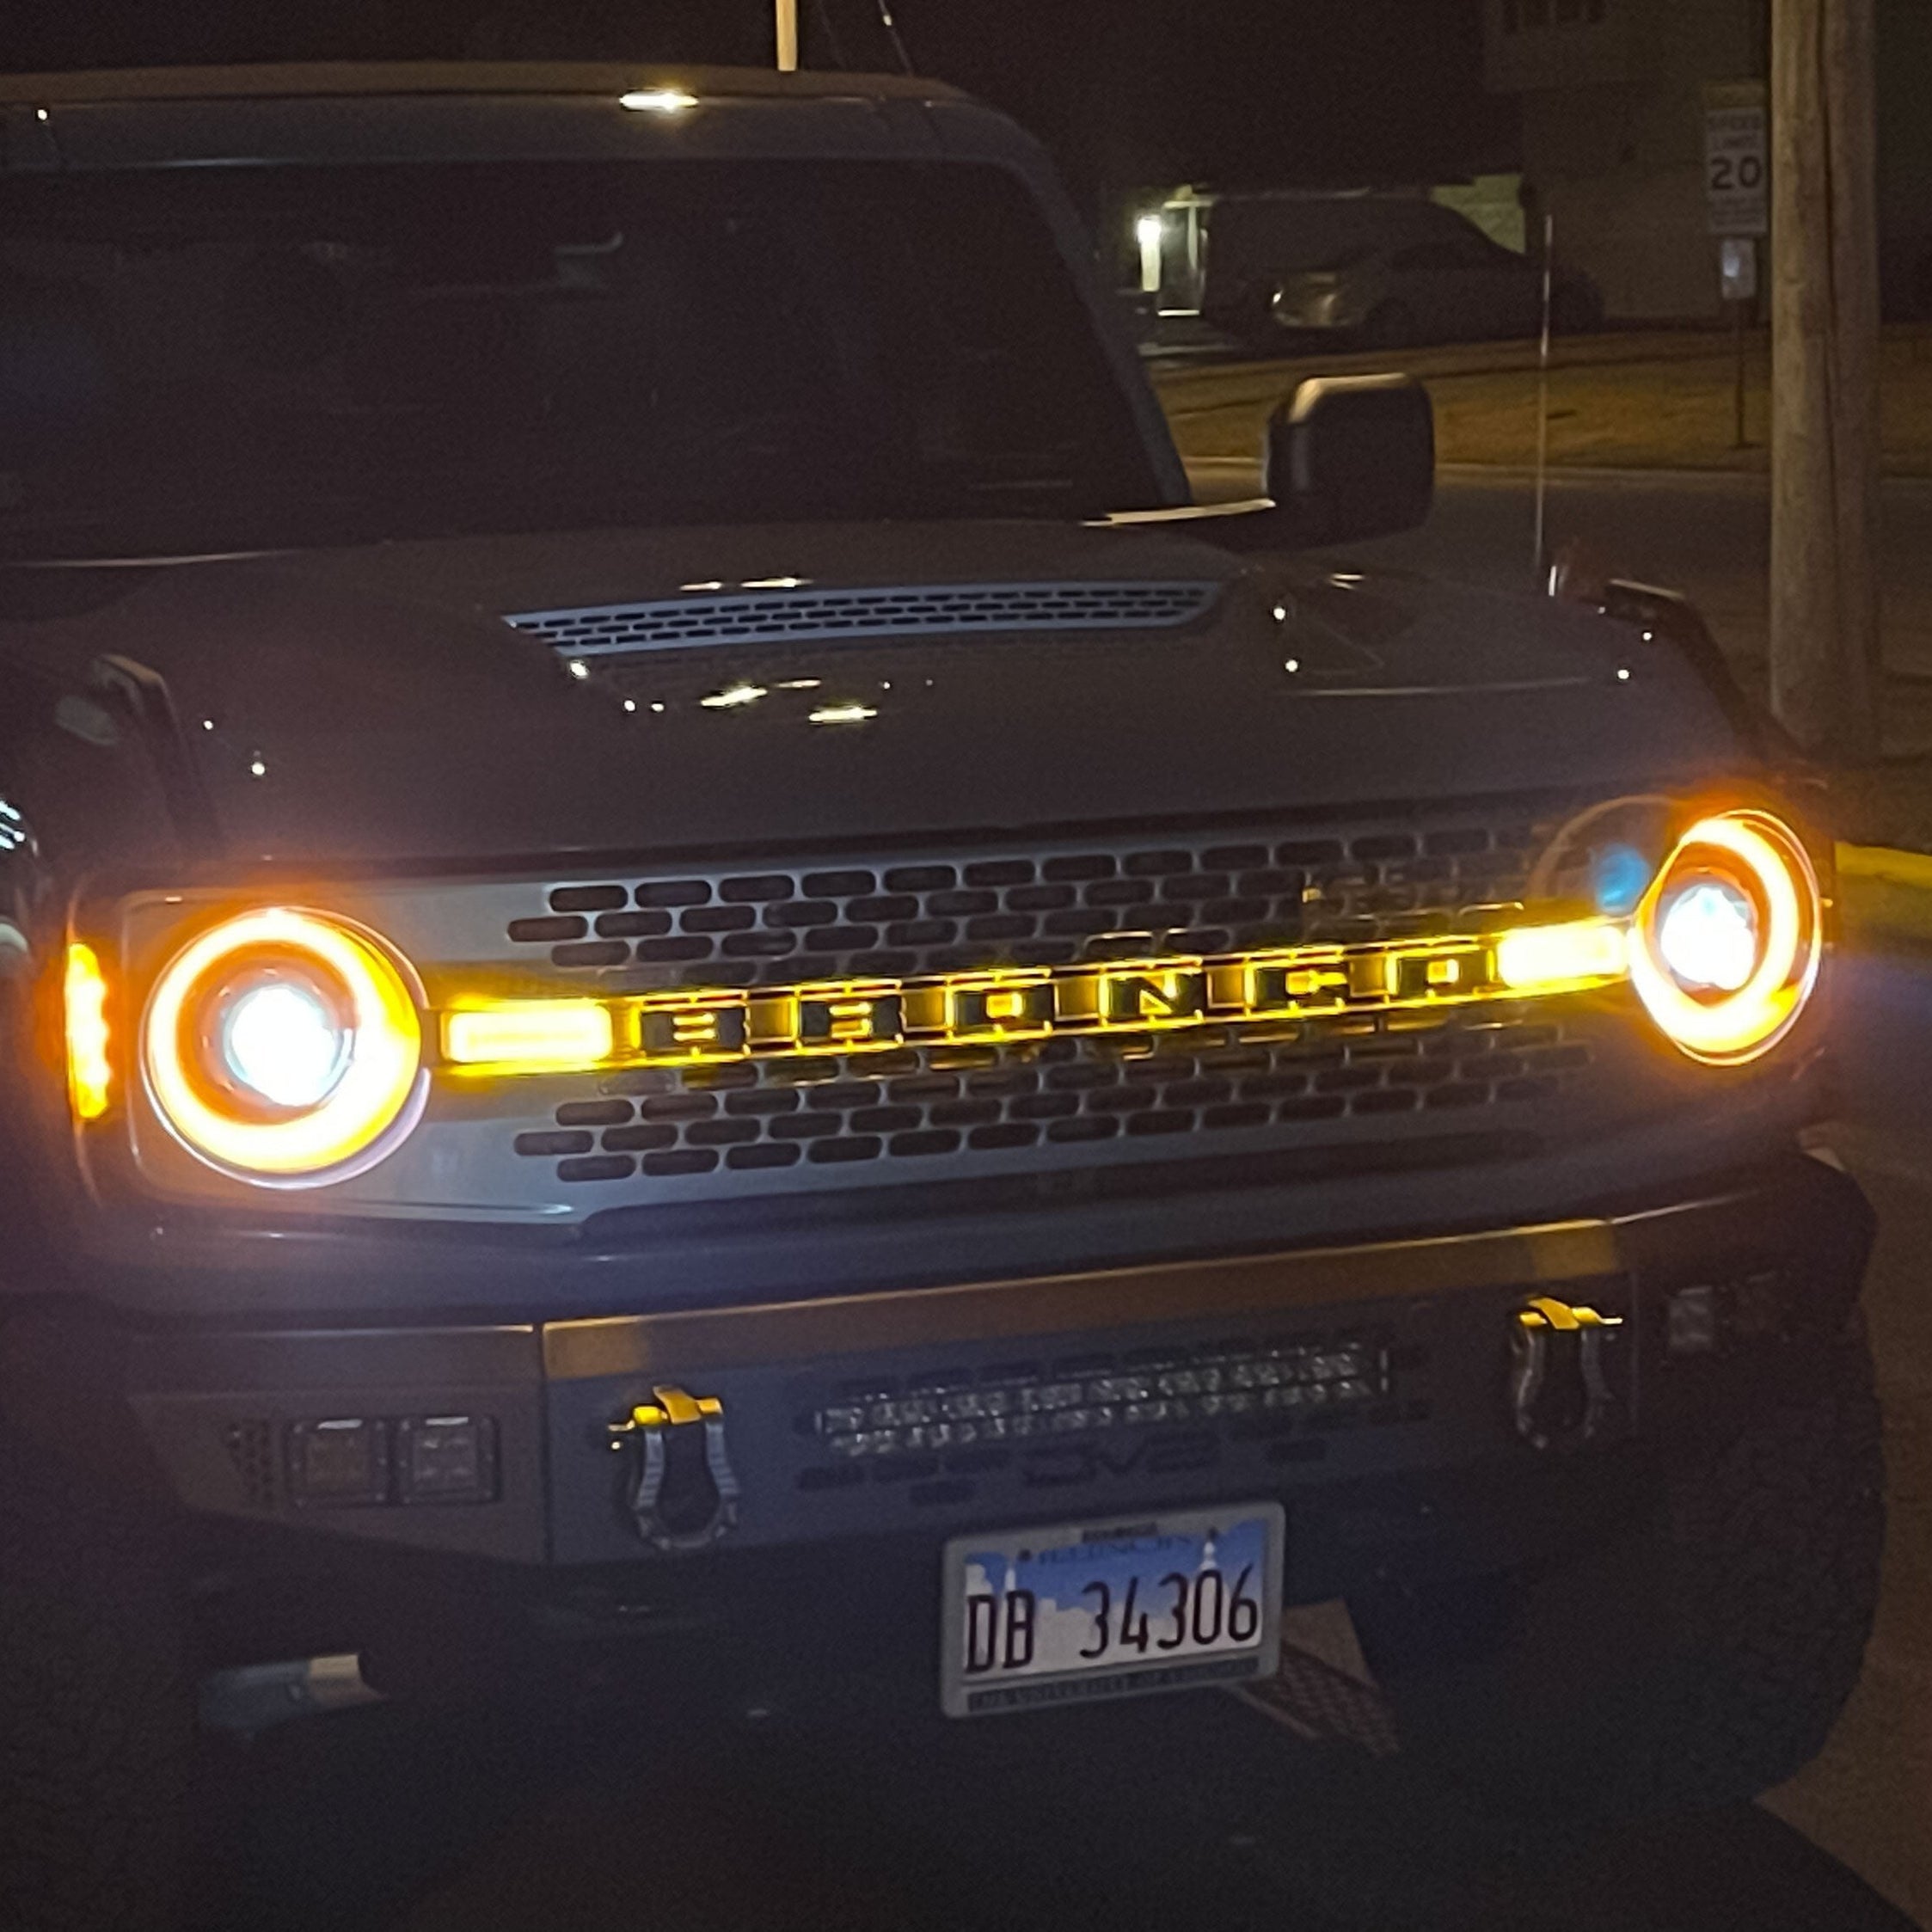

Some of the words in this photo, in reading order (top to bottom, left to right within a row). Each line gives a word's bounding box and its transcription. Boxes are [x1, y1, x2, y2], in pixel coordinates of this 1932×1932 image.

[1711, 156, 1762, 190] 20
[641, 952, 1487, 1056] BRONCO
[966, 1590, 1036, 1673] DB
[1080, 1563, 1258, 1659] 34306
